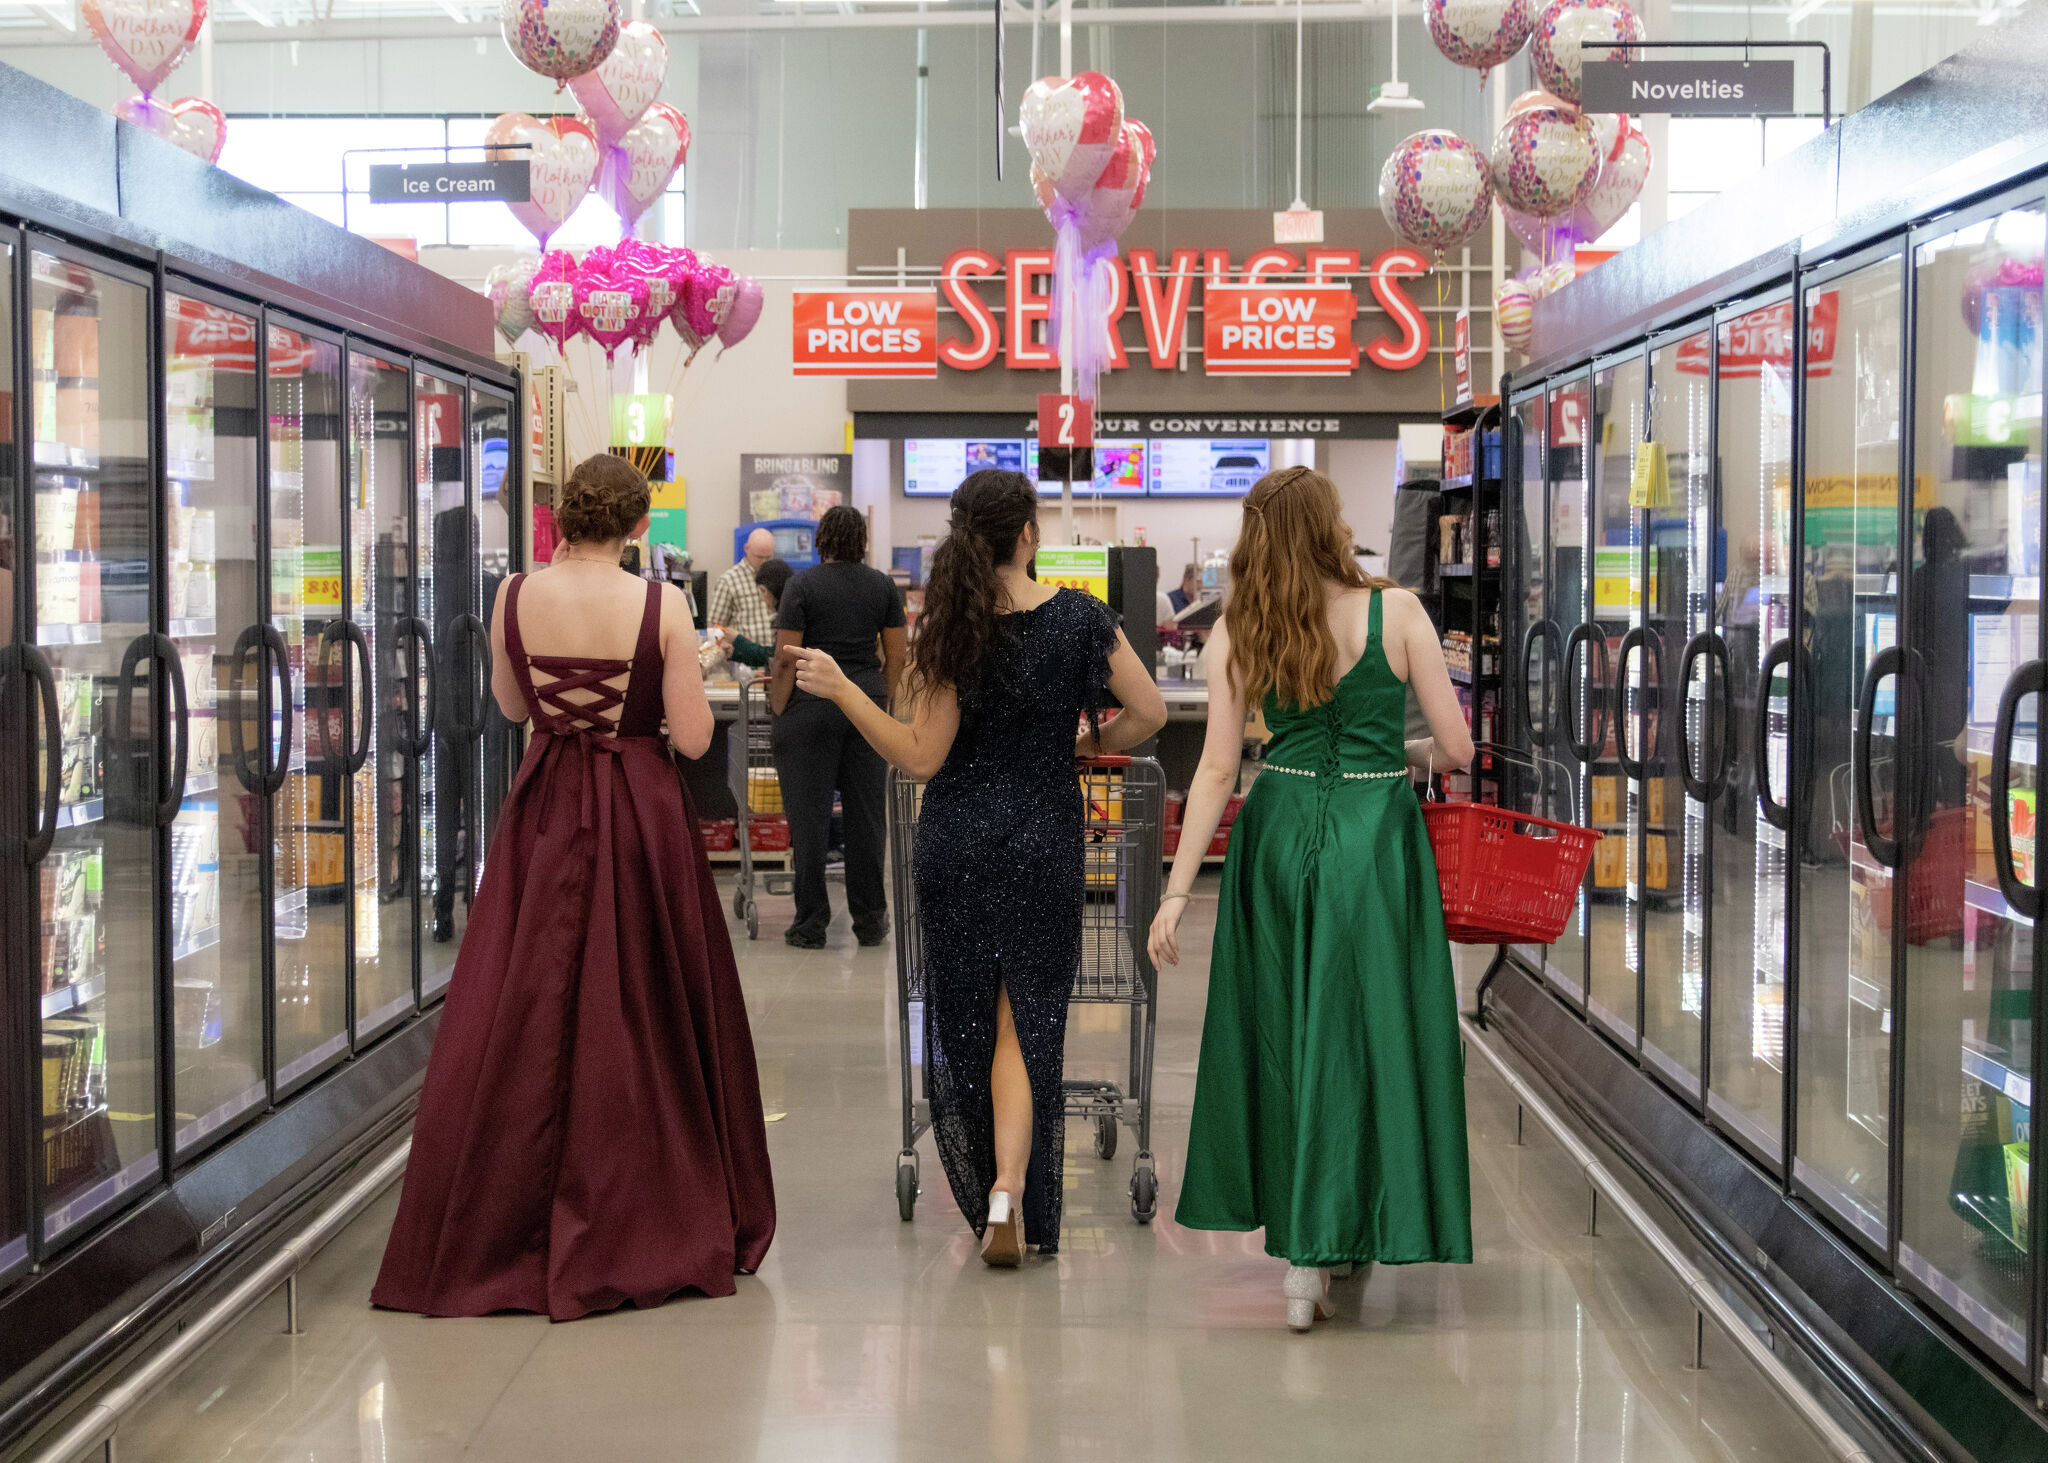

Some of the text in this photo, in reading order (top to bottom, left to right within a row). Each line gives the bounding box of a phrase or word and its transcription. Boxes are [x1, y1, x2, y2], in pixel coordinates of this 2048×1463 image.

[130, 38, 166, 57] DAY
[1631, 79, 1745, 100] Novelties
[403, 177, 496, 193] Ice Cream
[1436, 199, 1466, 223] Day
[826, 300, 903, 326] LOW
[1240, 297, 1317, 323] LOW
[808, 328, 922, 353] PRICES
[1222, 325, 1336, 350] PRICES
[627, 401, 646, 444] 3
[1058, 403, 1075, 444] 2
[1094, 419, 1141, 432] OUR
[1149, 418, 1341, 433] CONVENIENCE
[754, 457, 792, 474] BRING
[802, 457, 839, 474] BLING
